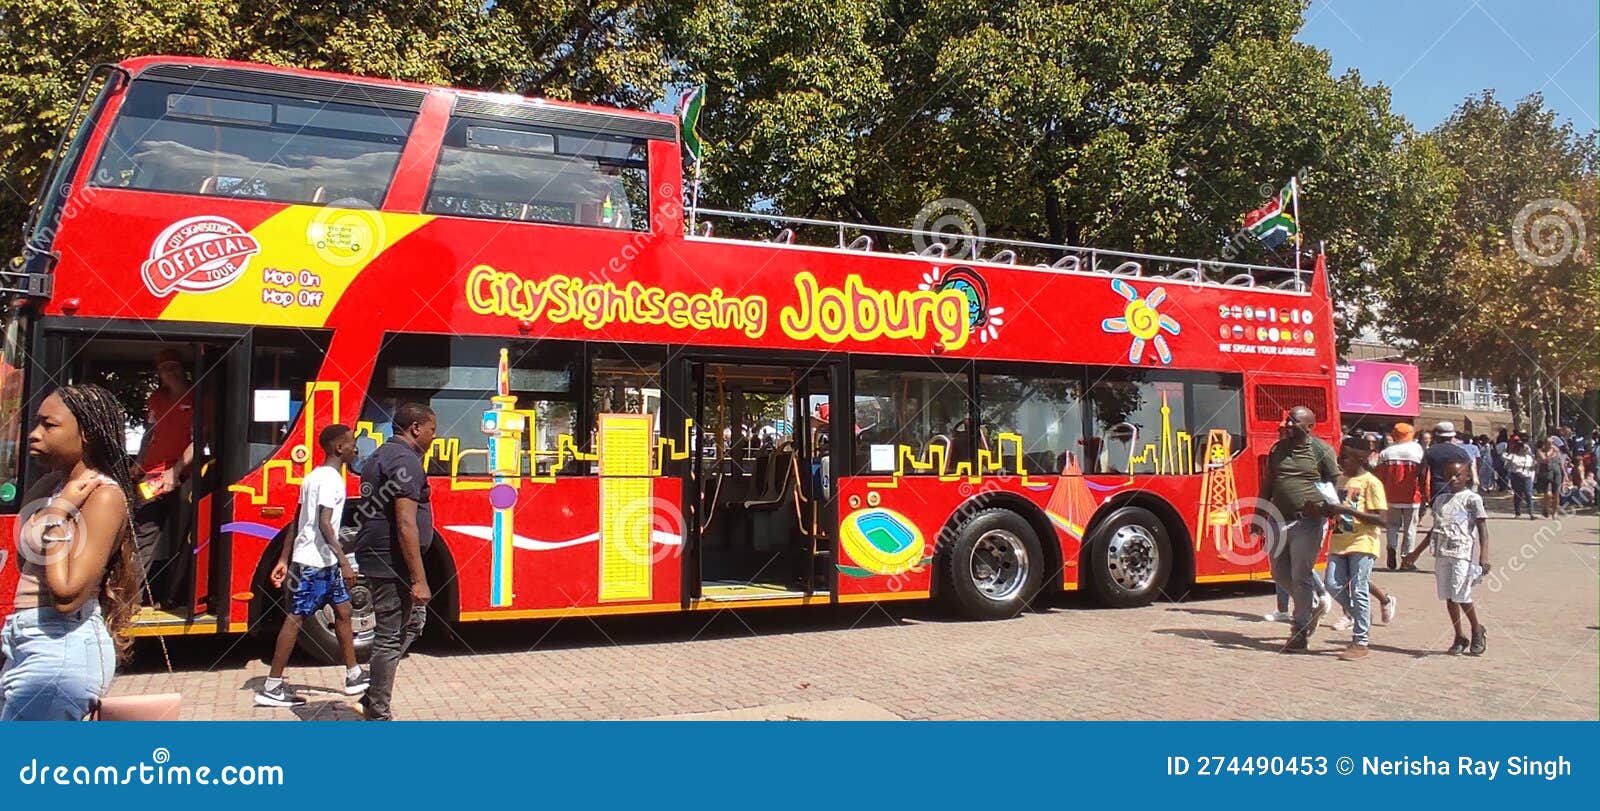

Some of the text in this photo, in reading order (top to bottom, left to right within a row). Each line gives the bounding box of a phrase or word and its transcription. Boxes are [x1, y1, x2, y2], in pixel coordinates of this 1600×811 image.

[157, 237, 249, 280] OFFICIAL
[206, 262, 236, 281] TOUR
[263, 268, 321, 287] Hop On
[262, 288, 324, 307] Hop Off
[466, 265, 971, 350] CitySightseeing Joburg
[1219, 343, 1316, 357] WE SPEAK YOUR LANGUAGE
